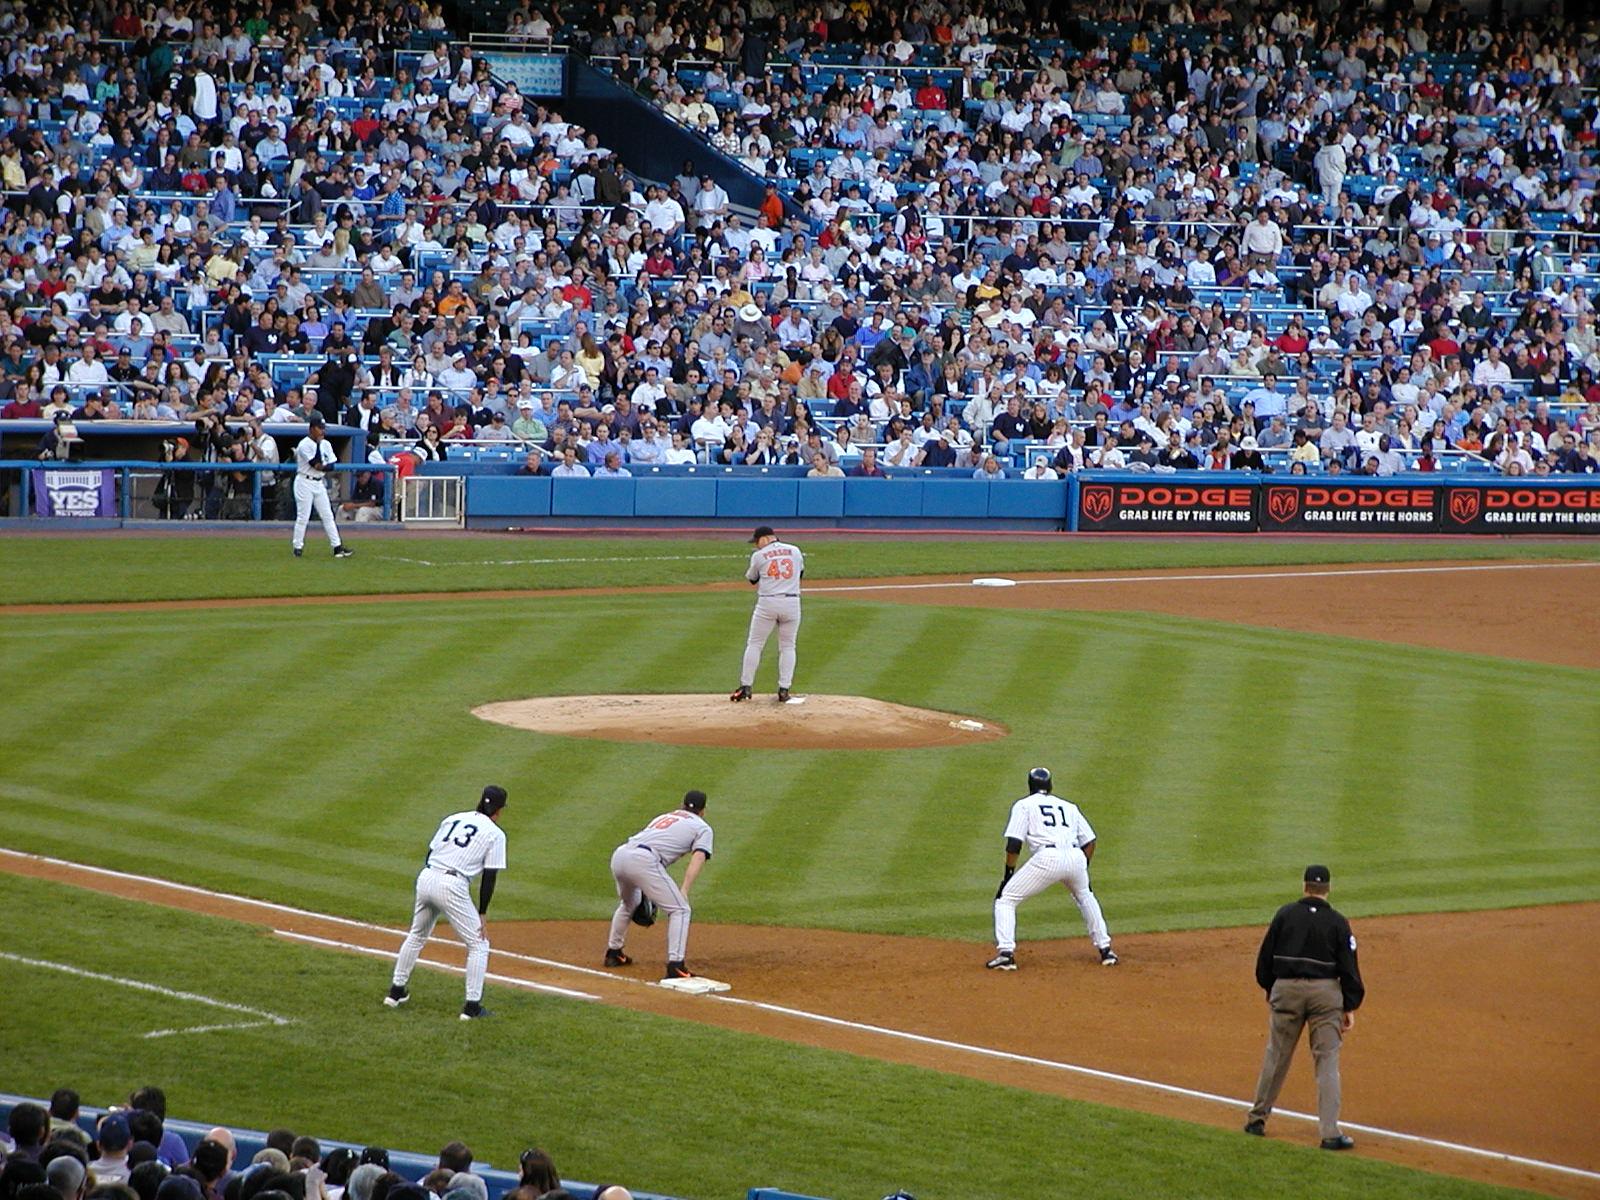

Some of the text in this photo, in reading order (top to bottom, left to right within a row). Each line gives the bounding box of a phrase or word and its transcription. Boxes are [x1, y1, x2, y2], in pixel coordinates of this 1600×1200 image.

[49, 490, 99, 510] YES
[1120, 488, 1251, 506] DODGE
[1305, 488, 1434, 507] DODGE
[1119, 509, 1251, 522] GRAB LIFE BY THE HORNS
[1304, 510, 1434, 522] GRAB LIFE BY THE HORNS
[1484, 511, 1600, 523] GRAB LIFE BY THE HOR
[767, 559, 793, 580] 43
[1038, 804, 1070, 828] 51
[442, 820, 479, 848] 13
